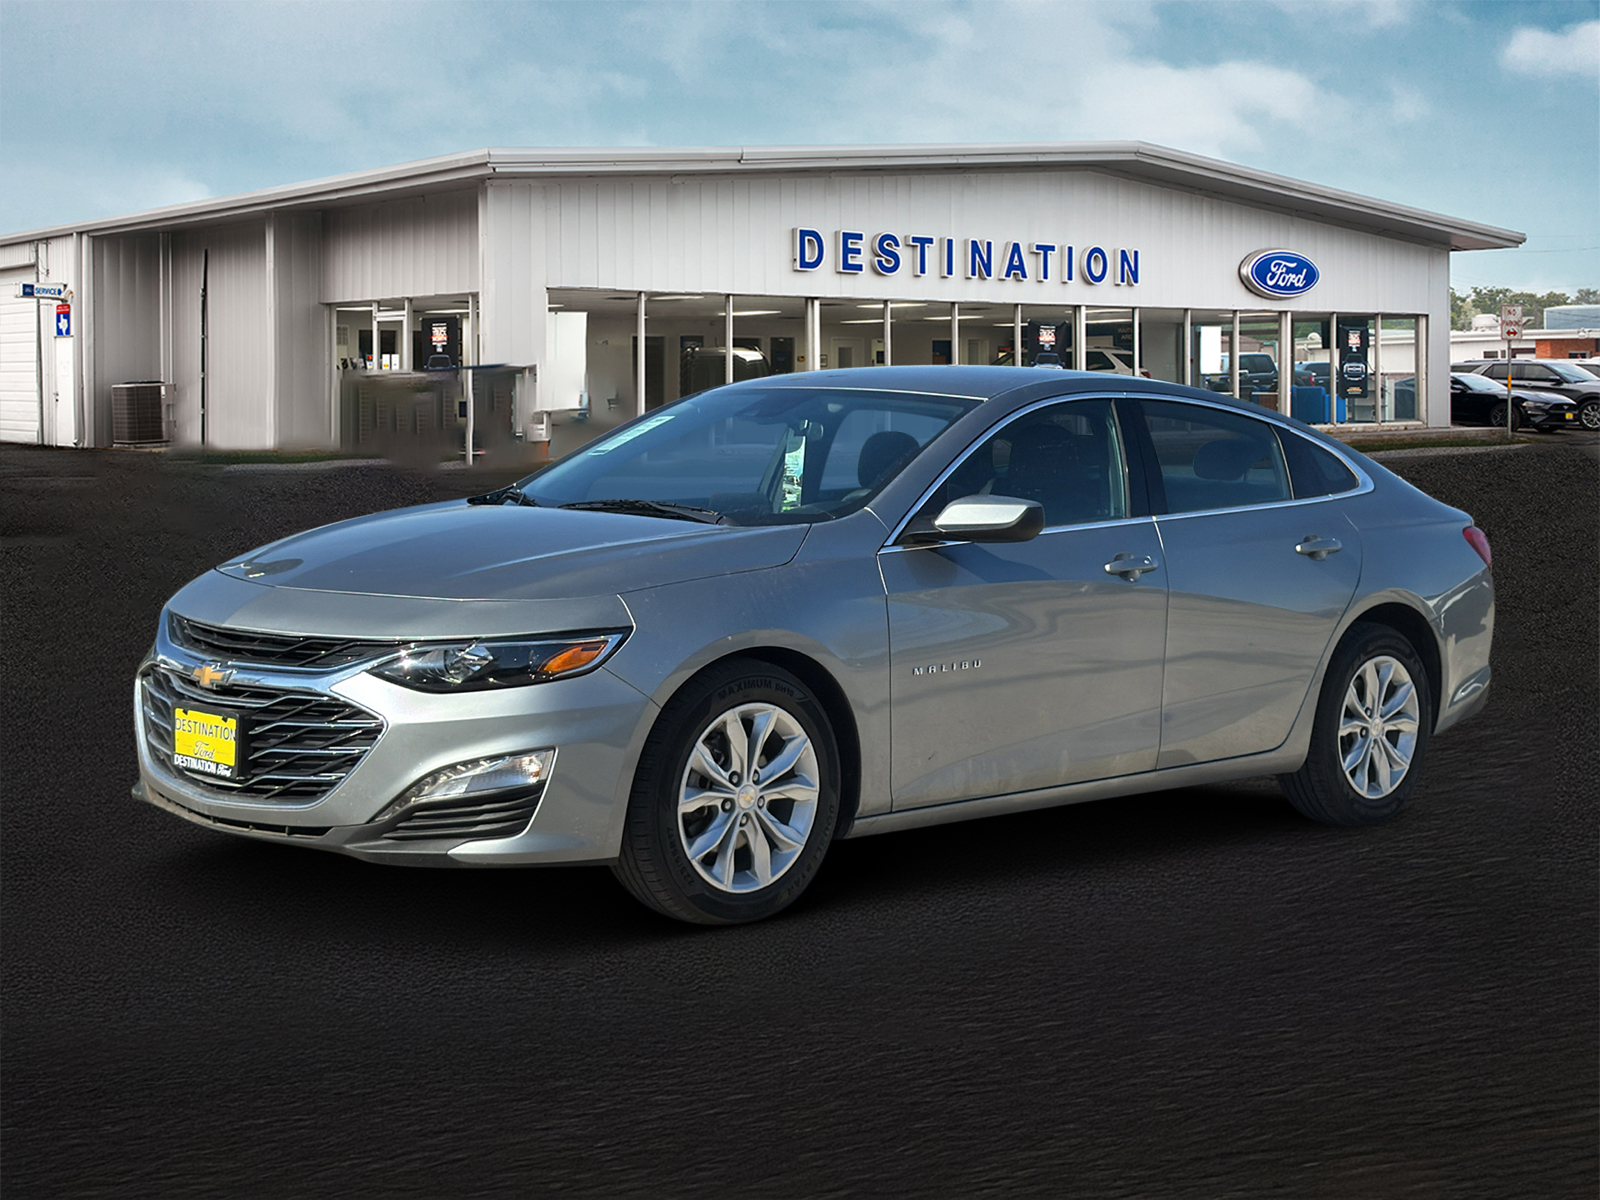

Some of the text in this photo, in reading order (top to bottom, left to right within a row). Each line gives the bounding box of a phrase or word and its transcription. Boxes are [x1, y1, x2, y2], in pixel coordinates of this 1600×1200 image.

[793, 227, 1140, 286] DESTINATION
[1266, 260, 1307, 287] Ford
[35, 287, 57, 296] SERVICE
[912, 660, 981, 676] MALIBU
[717, 679, 772, 700] MAXIMUM
[175, 718, 236, 741] DESTINATION
[193, 740, 215, 759] Ford
[174, 754, 216, 774] DESTINATION
